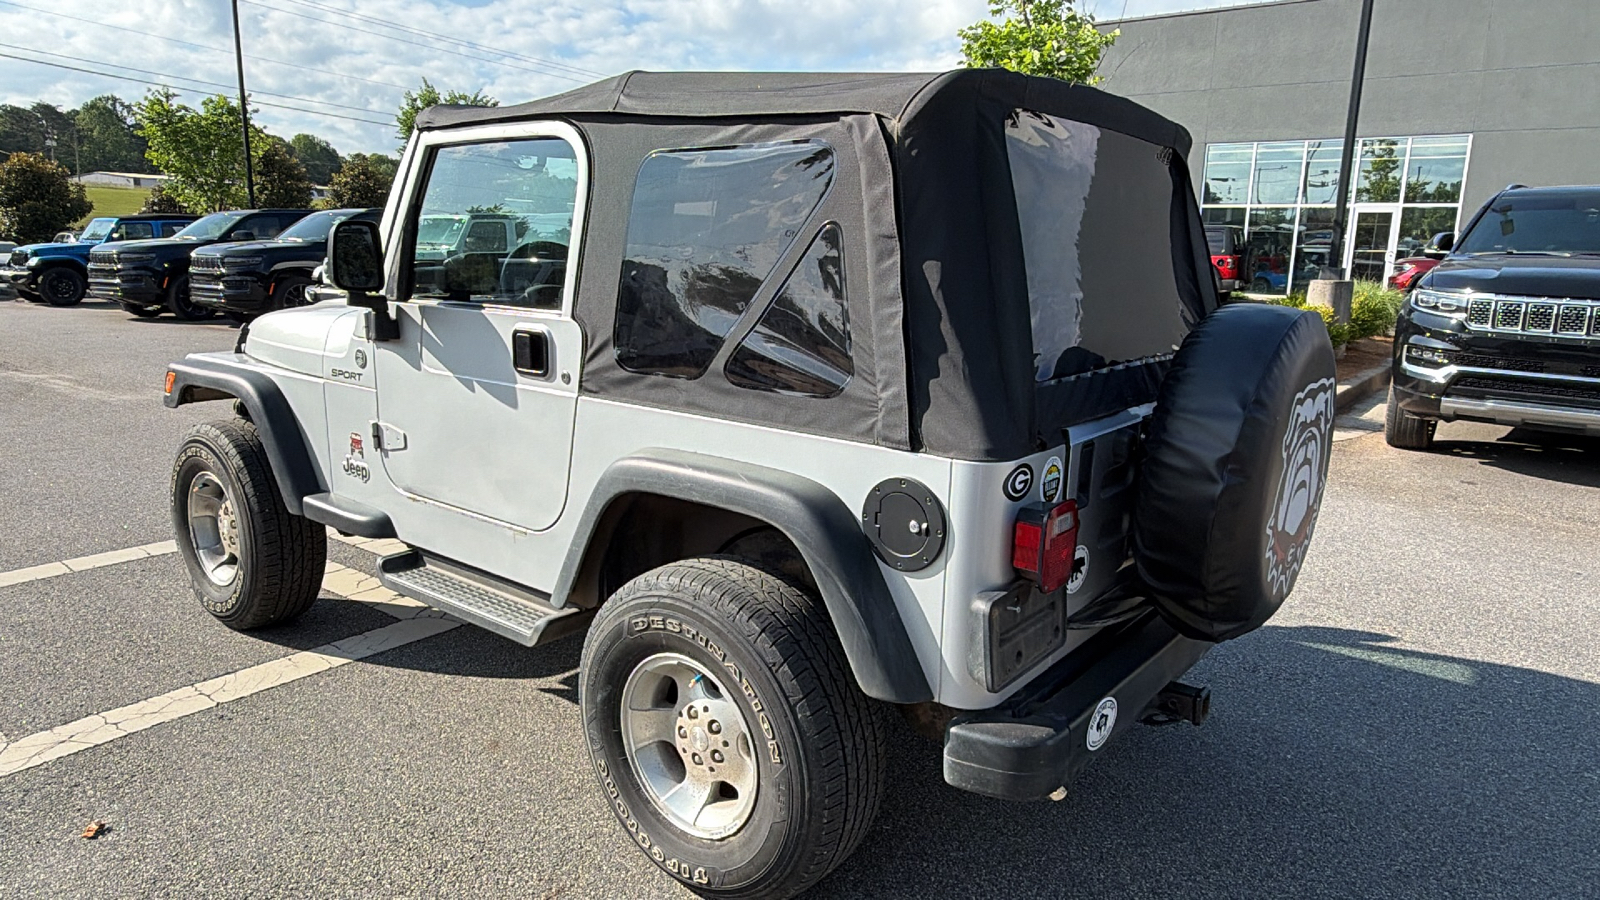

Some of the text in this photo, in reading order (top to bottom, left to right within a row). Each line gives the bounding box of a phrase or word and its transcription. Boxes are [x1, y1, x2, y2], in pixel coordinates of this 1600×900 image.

[331, 368, 363, 381] SPORT
[342, 456, 370, 484] Jeep
[1006, 466, 1031, 499] G
[631, 616, 782, 764] DESTINATION
